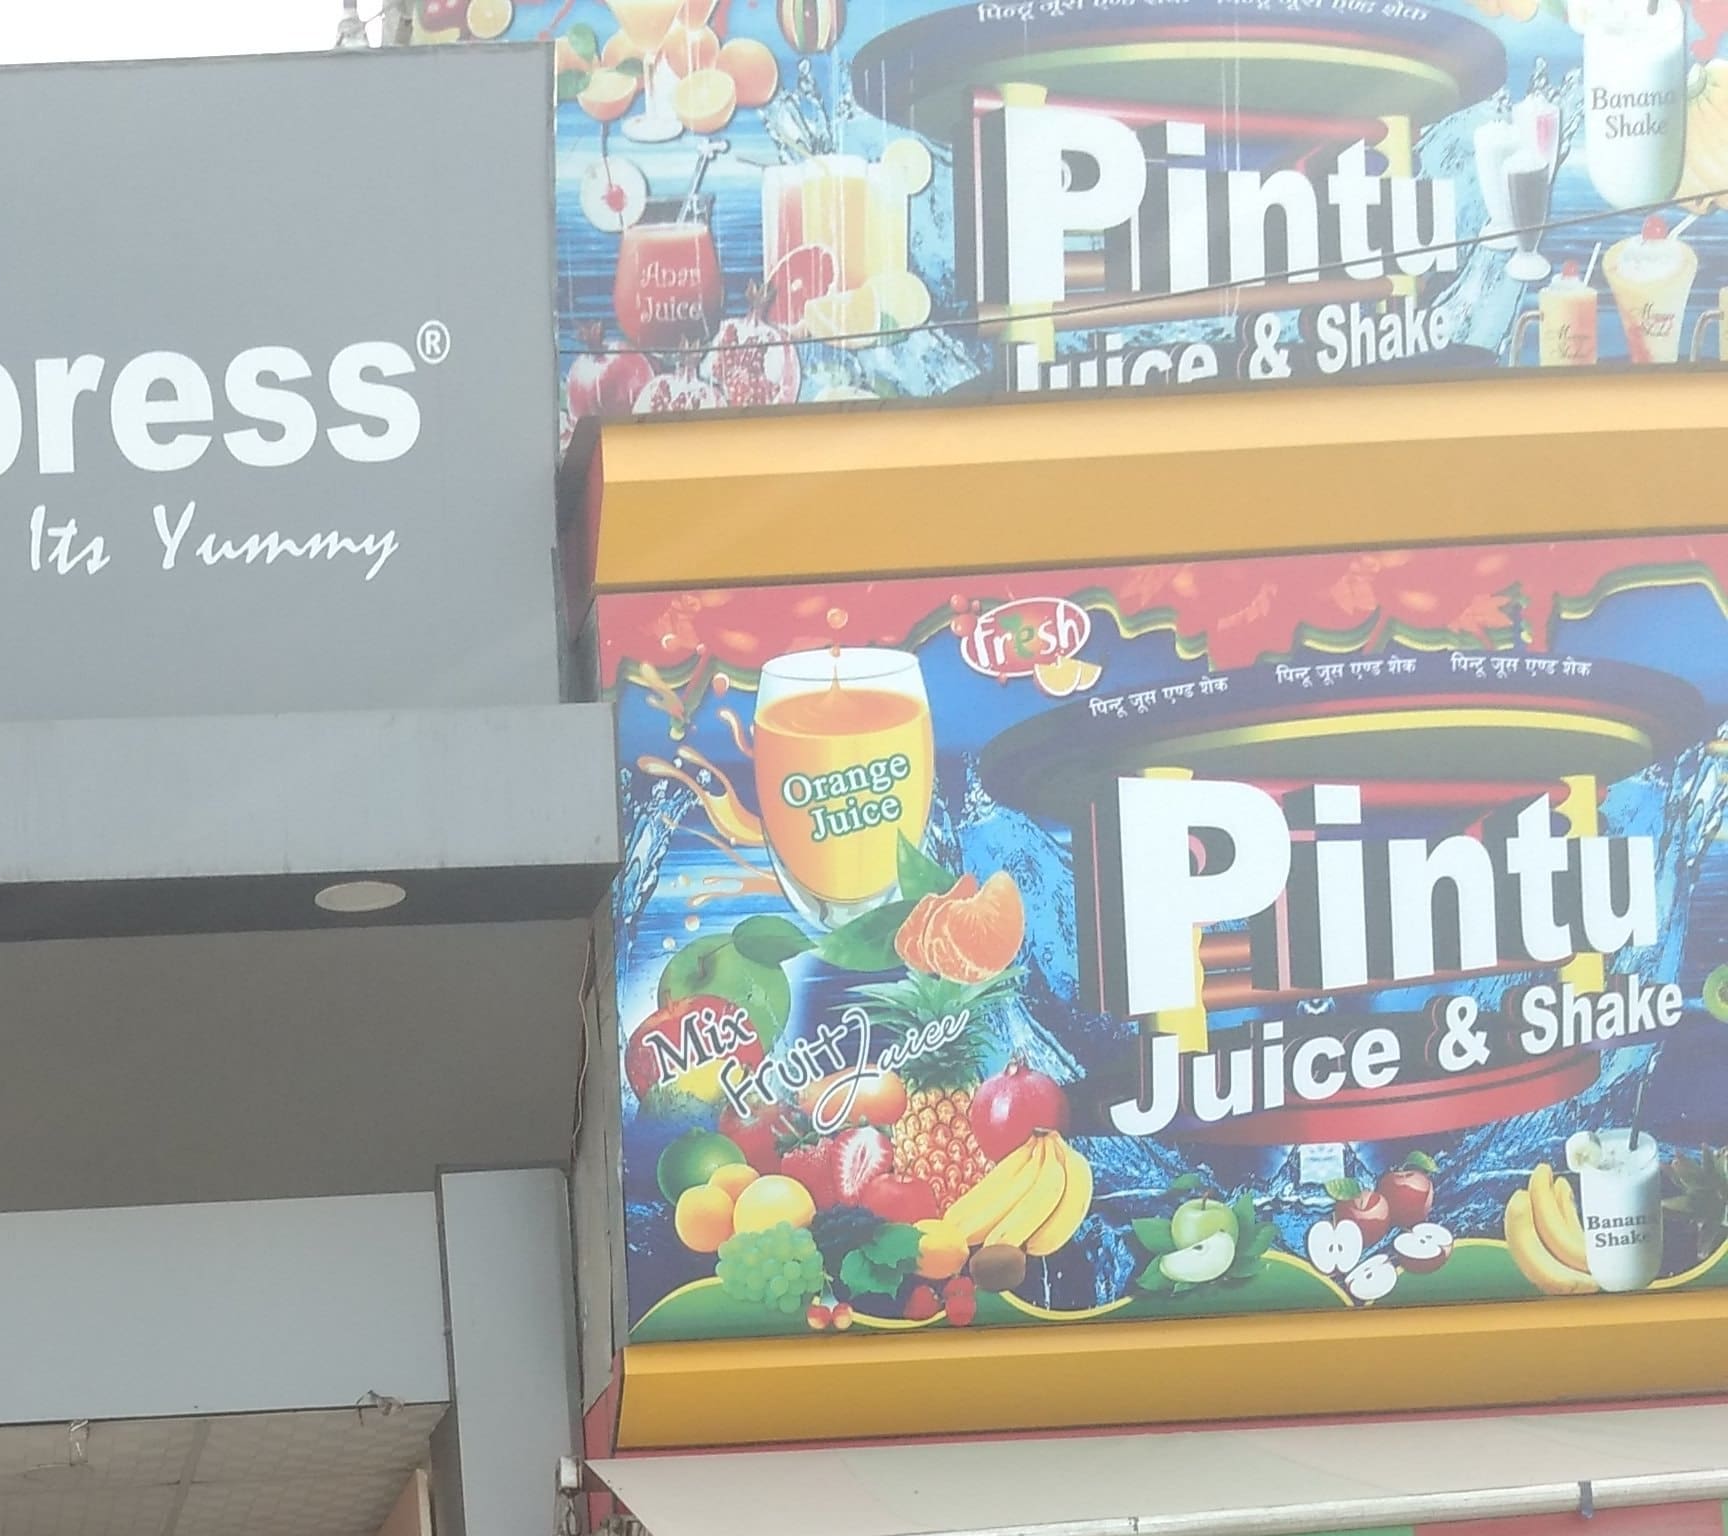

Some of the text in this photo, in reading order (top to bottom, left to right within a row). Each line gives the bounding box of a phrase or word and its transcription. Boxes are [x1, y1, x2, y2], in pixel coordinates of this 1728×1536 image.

[1605, 112, 1668, 140] Shake
[1004, 106, 1459, 303] Pintu
[639, 295, 703, 324] Juice
[1248, 311, 1291, 380] &
[1316, 295, 1450, 375] Shake
[30, 500, 399, 580] Its Yummy
[974, 600, 1082, 668] Fresh
[1129, 690, 1157, 713] जूस
[1199, 675, 1229, 694] शेक
[1315, 664, 1344, 686] जूस
[1386, 654, 1417, 674] शेक
[1490, 654, 1520, 679] जूस
[1562, 655, 1593, 677] शेक
[781, 753, 911, 809] Orange
[810, 794, 903, 843] Juice
[1118, 777, 1658, 1015] Pintu
[645, 1002, 757, 1087] Mix
[719, 1007, 969, 1133] Fruit Juice
[1109, 975, 1683, 1137] Juice & Shake
[1586, 1214, 1647, 1231] Banan
